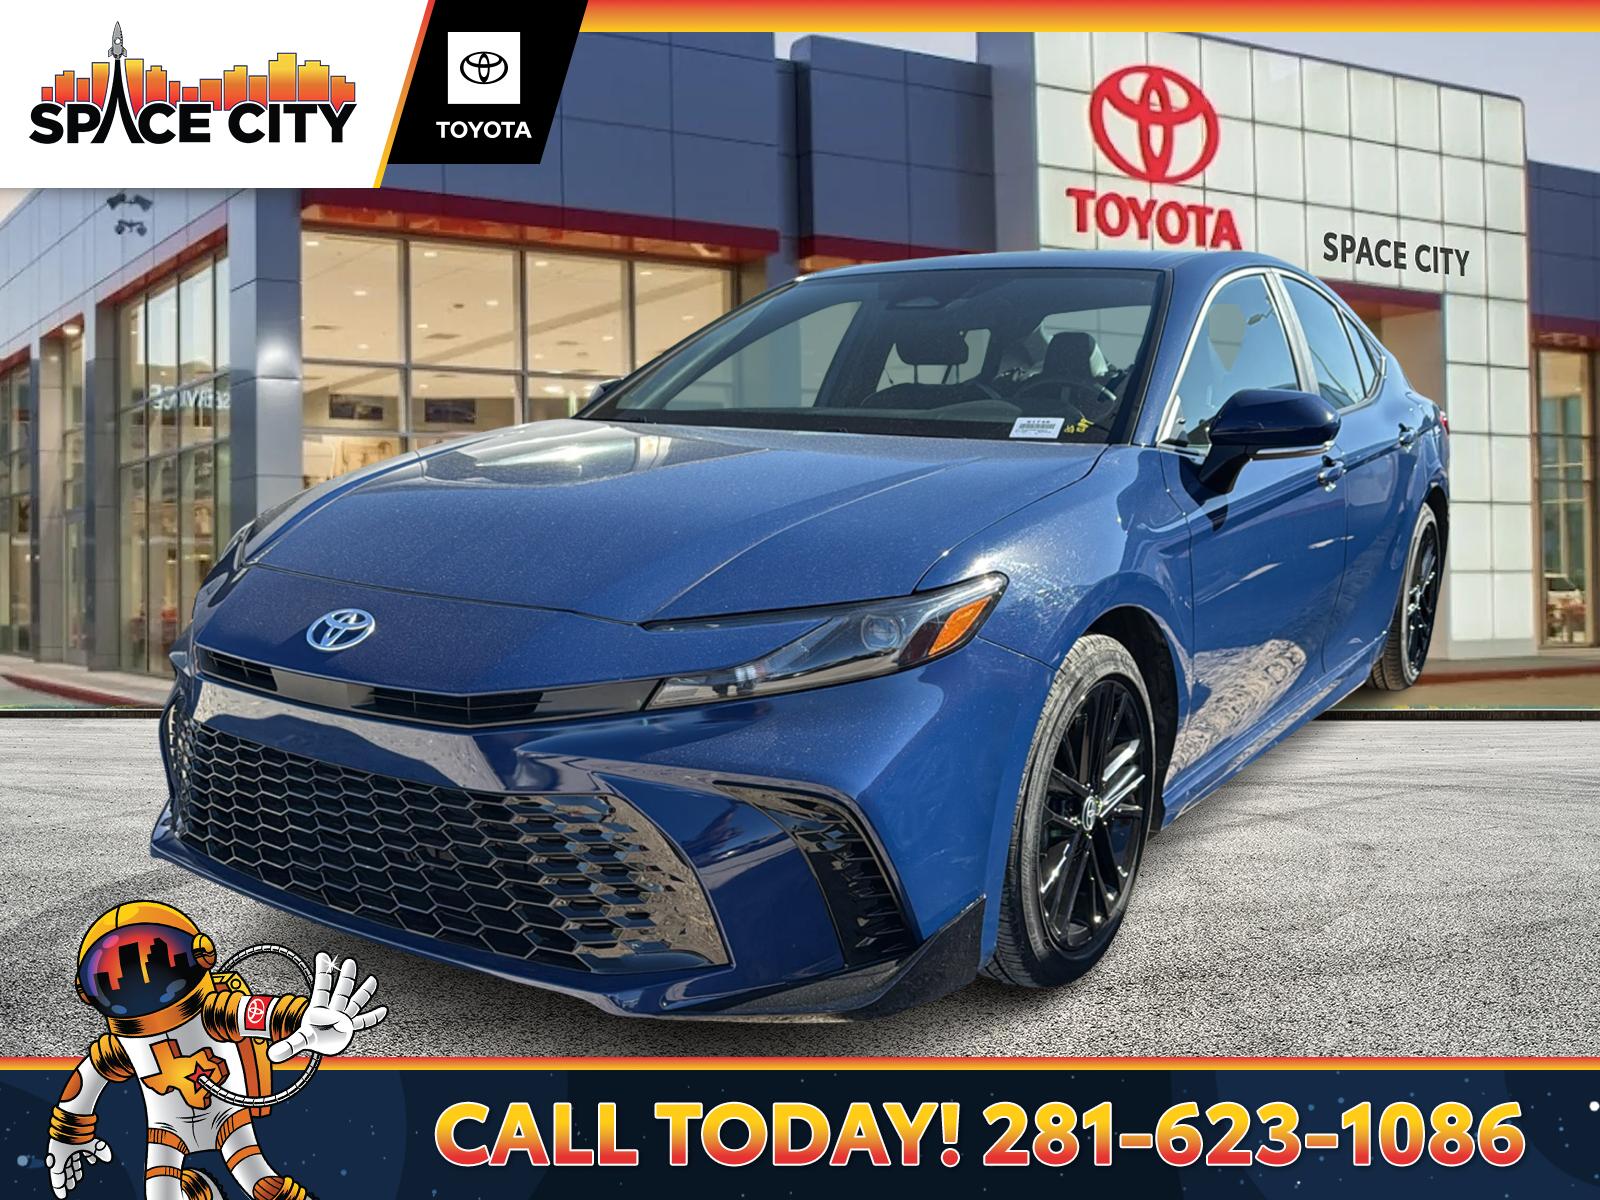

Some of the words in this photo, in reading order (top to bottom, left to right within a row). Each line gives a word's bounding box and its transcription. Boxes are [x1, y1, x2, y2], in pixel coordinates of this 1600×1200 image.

[1066, 187, 1243, 251] TOYOTA
[1322, 231, 1407, 270] SPACE
[1414, 243, 1470, 277] CITY
